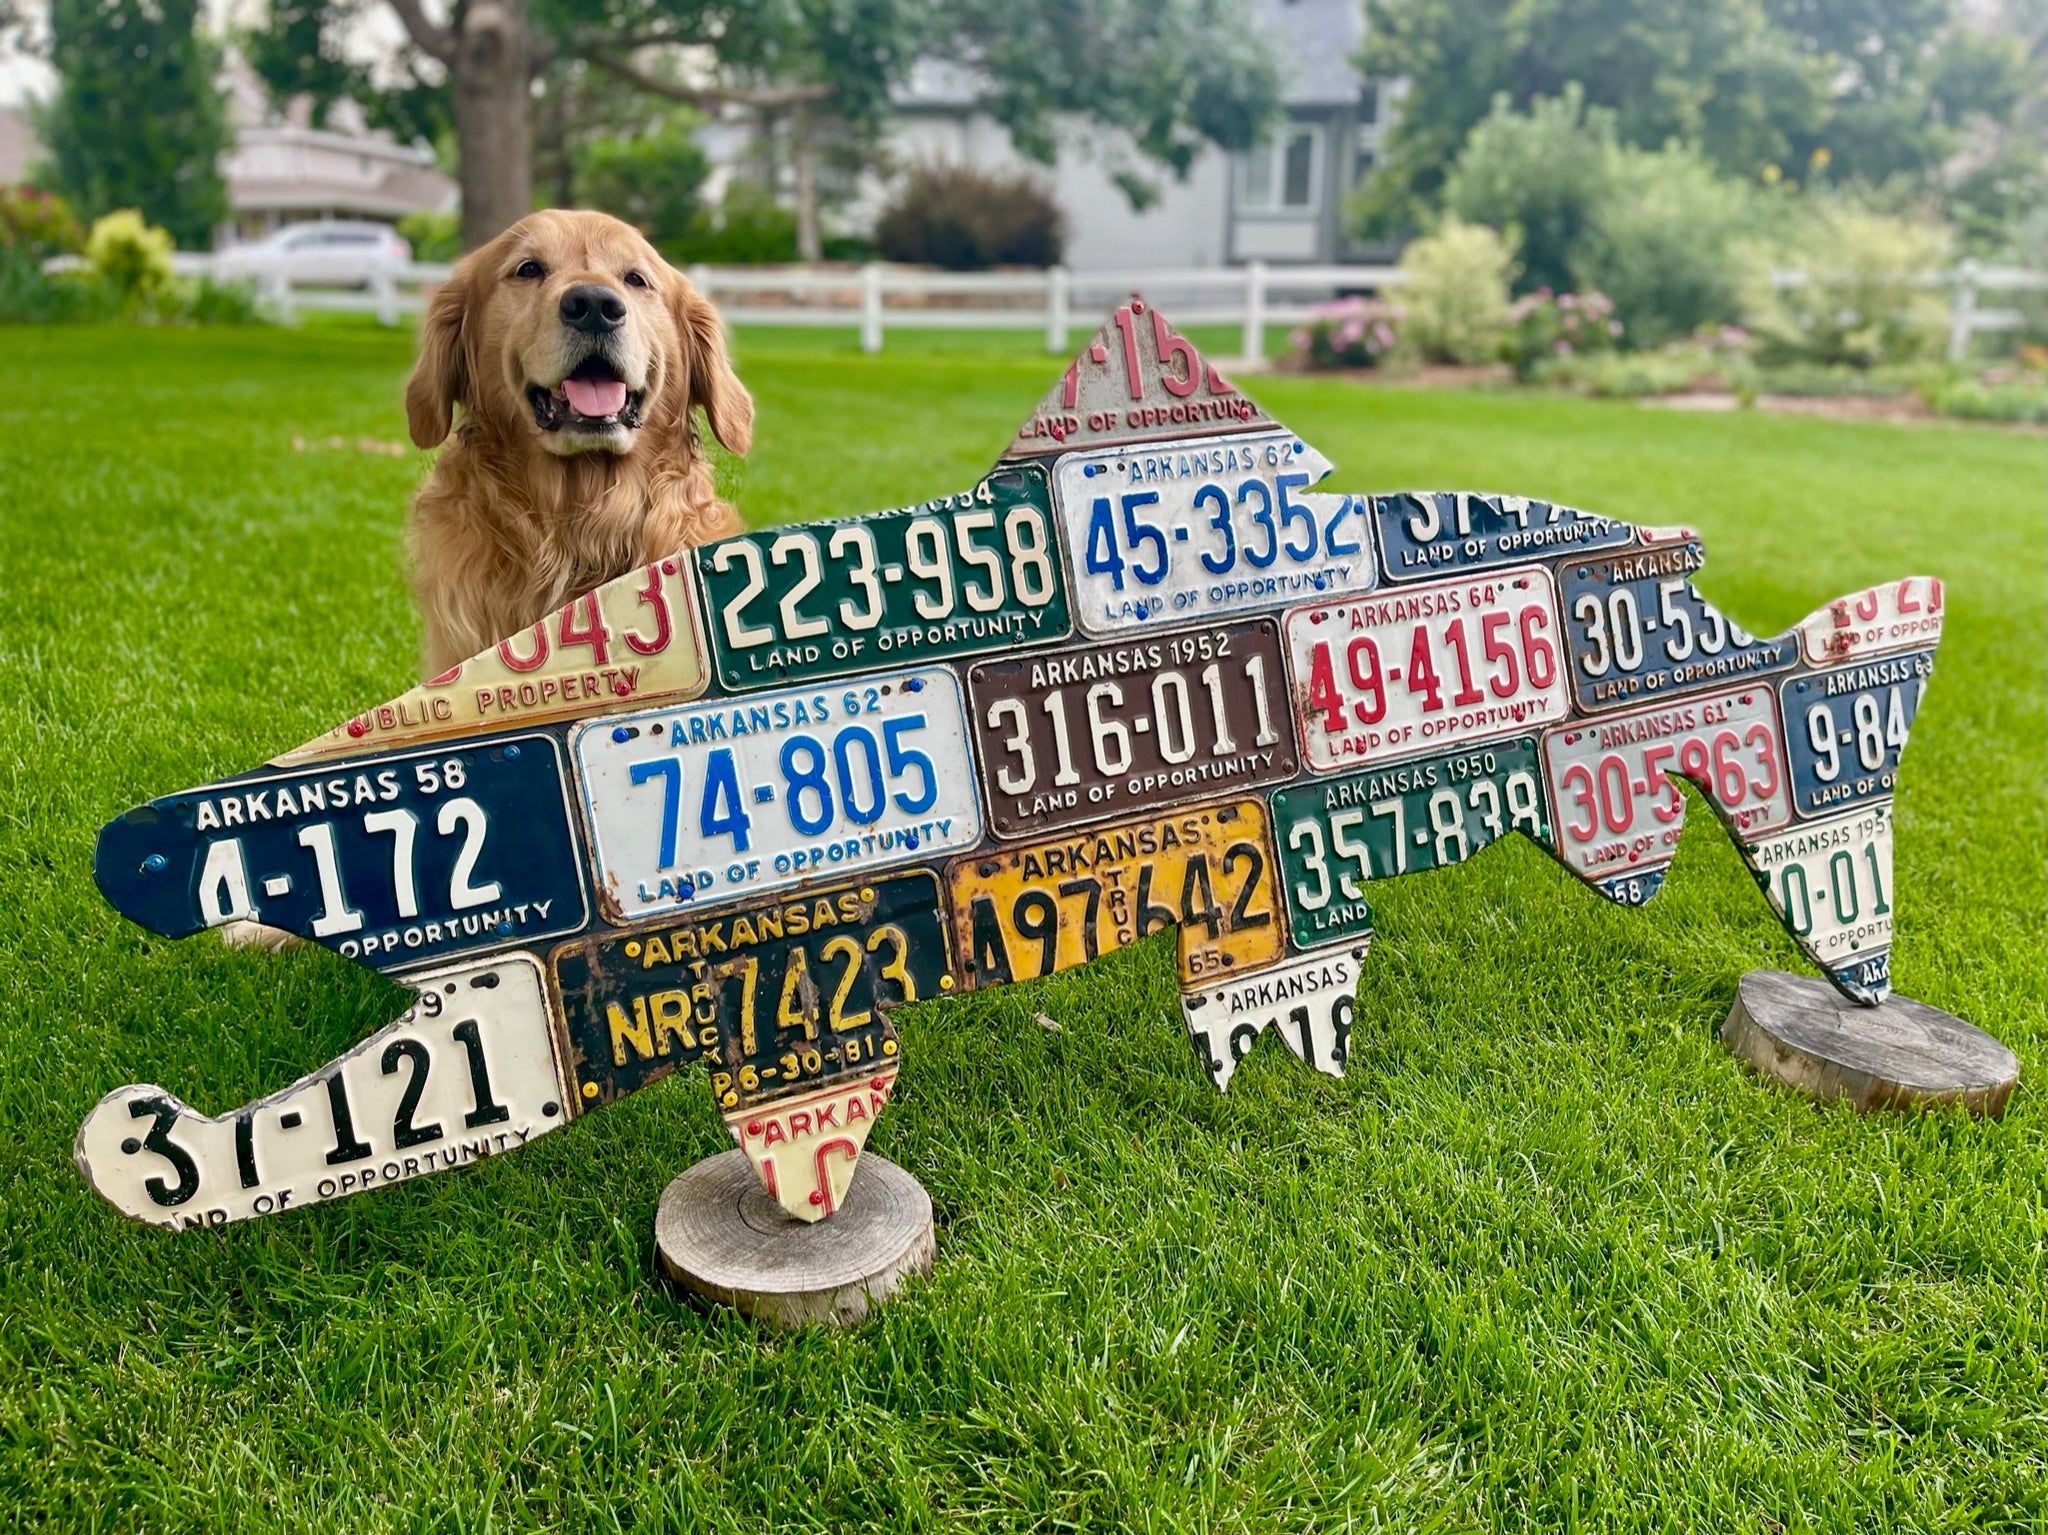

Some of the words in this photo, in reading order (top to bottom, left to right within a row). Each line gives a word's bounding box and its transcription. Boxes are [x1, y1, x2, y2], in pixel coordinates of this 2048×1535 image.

[1088, 412, 1117, 431] OF
[1131, 447, 1255, 483] ARKANSAS
[1265, 442, 1295, 466] 62
[1086, 472, 1362, 592] 45-3352
[1464, 538, 1487, 557] OF
[712, 506, 1056, 650] 223-958
[1612, 549, 1706, 583] ARKANSAS
[1105, 595, 1165, 621] LAND
[1174, 588, 1199, 609] OF
[1351, 590, 1461, 630] ARKANSAS
[1469, 584, 1496, 608] 64
[749, 646, 820, 672] LAND
[832, 639, 866, 659] OF
[878, 611, 1045, 653] OPPORTUNITY
[1866, 627, 1884, 642] OF
[1031, 645, 1162, 689] ARKANSAS
[1169, 632, 1232, 665] 1952
[1310, 604, 1557, 733] 49-4156
[1646, 673, 1665, 689] OF
[1827, 660, 1910, 697] ARKANSAS
[1915, 657, 1933, 675] 63
[476, 667, 640, 713] PROPERTY
[671, 697, 831, 748] ARKANSAS
[843, 687, 882, 717] 62
[986, 655, 1279, 796] 316-011
[1601, 709, 1696, 750] ARKANSAS
[1703, 704, 1728, 724] 61
[1329, 732, 1381, 756] LAND
[1387, 726, 1413, 744] OF
[197, 770, 400, 832] ARKANSAS
[415, 759, 466, 795] 58
[628, 712, 939, 870] 74-805
[1017, 790, 1077, 818] LAND
[1088, 784, 1116, 804] OF
[1128, 752, 1274, 796] OPPORTUNITY
[1325, 765, 1438, 810] ARKANSAS
[1447, 752, 1496, 782] 1950
[1562, 721, 1779, 843] 30-5863
[1812, 783, 1852, 806] LAND
[1857, 778, 1875, 795] OF
[1022, 818, 1203, 882] ARKANSAS
[1288, 770, 1541, 911] 357-838
[1583, 844, 1628, 867] LAND
[1634, 835, 1655, 853] OF
[1763, 826, 1850, 865] ARKANSAS
[639, 870, 714, 902] LAND
[727, 859, 762, 883] OF
[1613, 879, 1642, 904] 58
[642, 893, 862, 969] ARKANSAS
[971, 877, 1103, 989] A97
[1136, 842, 1271, 939] 642
[1315, 905, 1368, 931] LAND
[1188, 949, 1220, 975] 65
[1231, 962, 1349, 1015] ARKANSAS
[252, 1188, 293, 1216] OF
